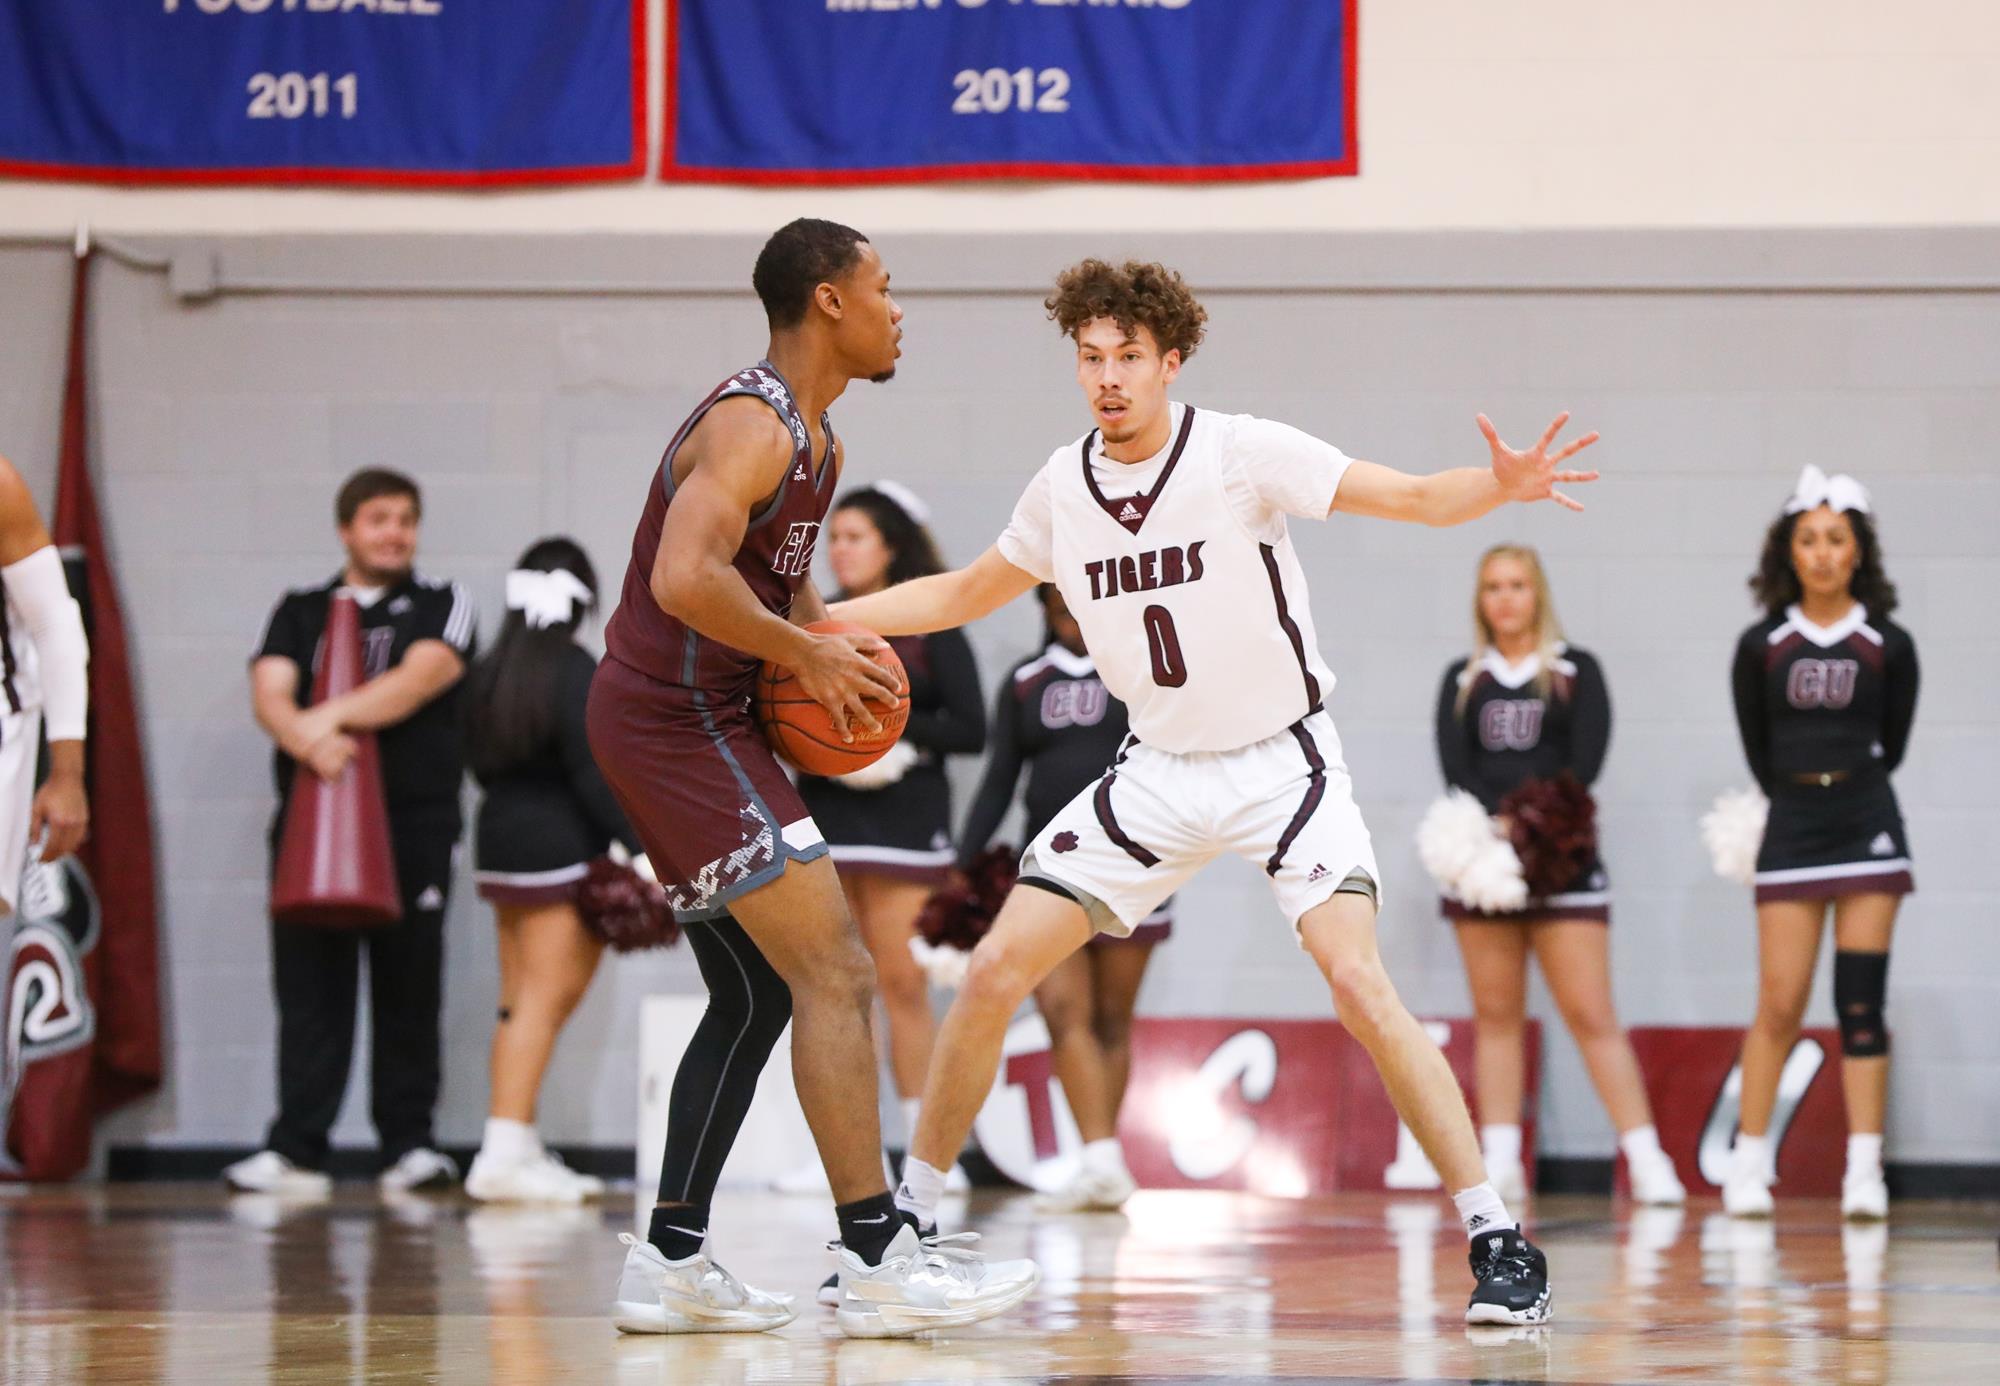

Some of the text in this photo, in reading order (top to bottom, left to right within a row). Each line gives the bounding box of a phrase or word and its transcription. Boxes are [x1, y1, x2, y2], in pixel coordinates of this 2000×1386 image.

[246, 71, 358, 119] 2011
[952, 66, 1070, 114] 2012
[1085, 540, 1206, 601] TIGERS
[1143, 604, 1187, 688] 0
